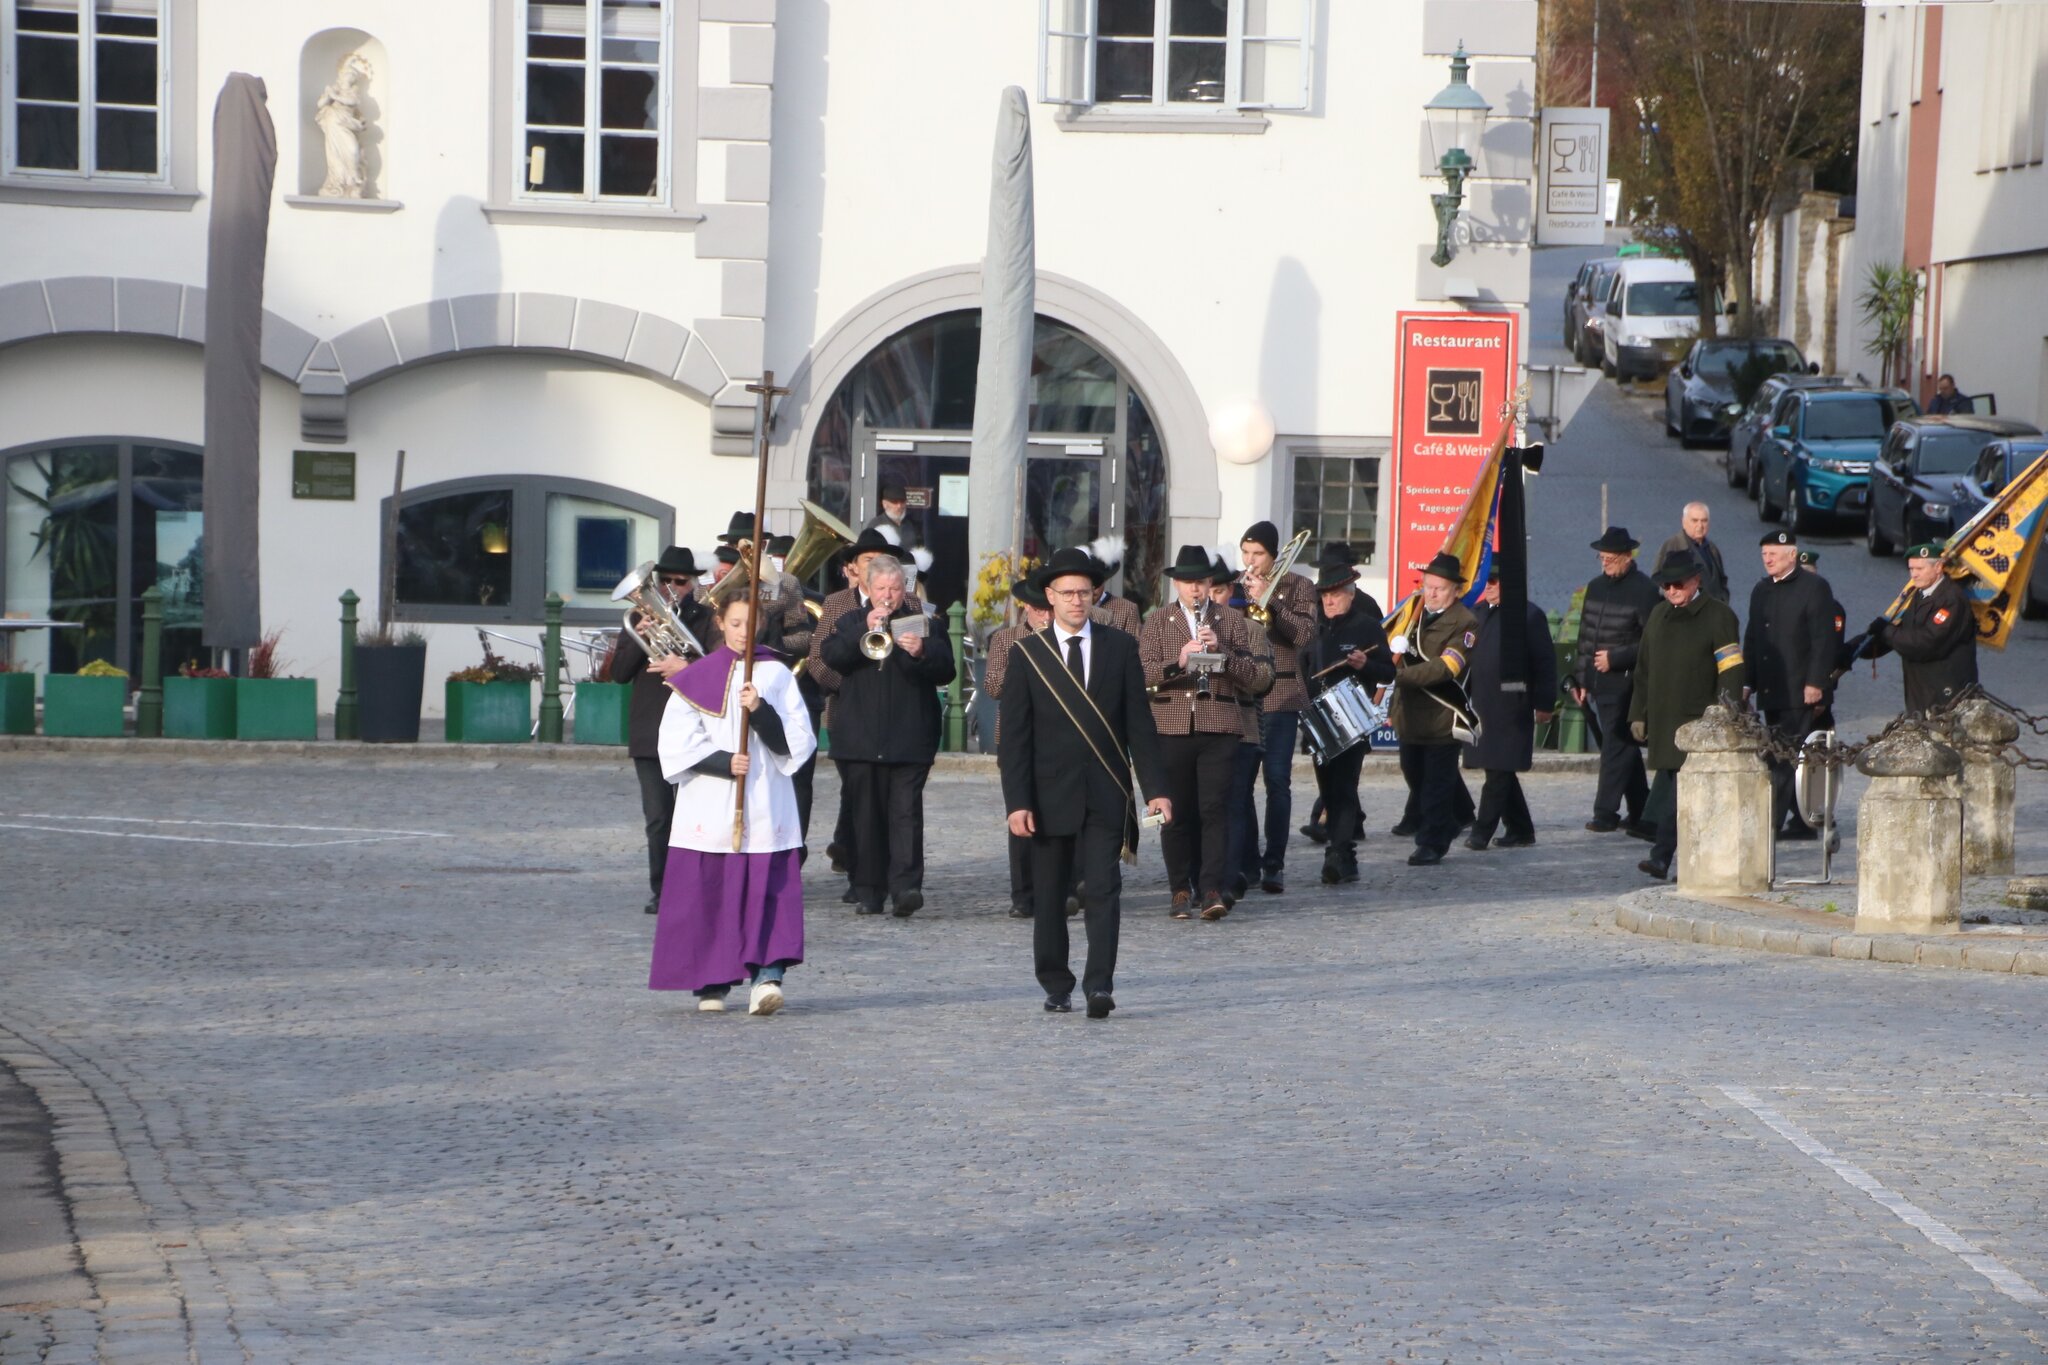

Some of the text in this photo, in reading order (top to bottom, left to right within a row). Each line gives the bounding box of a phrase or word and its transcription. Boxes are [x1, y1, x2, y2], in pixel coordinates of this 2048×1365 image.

[1412, 332, 1501, 348] Restaurant
[1414, 442, 1443, 456] Café
[1445, 443, 1456, 456] &
[1406, 485, 1440, 496] Speisen
[1443, 486, 1450, 494] &
[1410, 522, 1435, 532] Pasta
[1438, 523, 1445, 531] &
